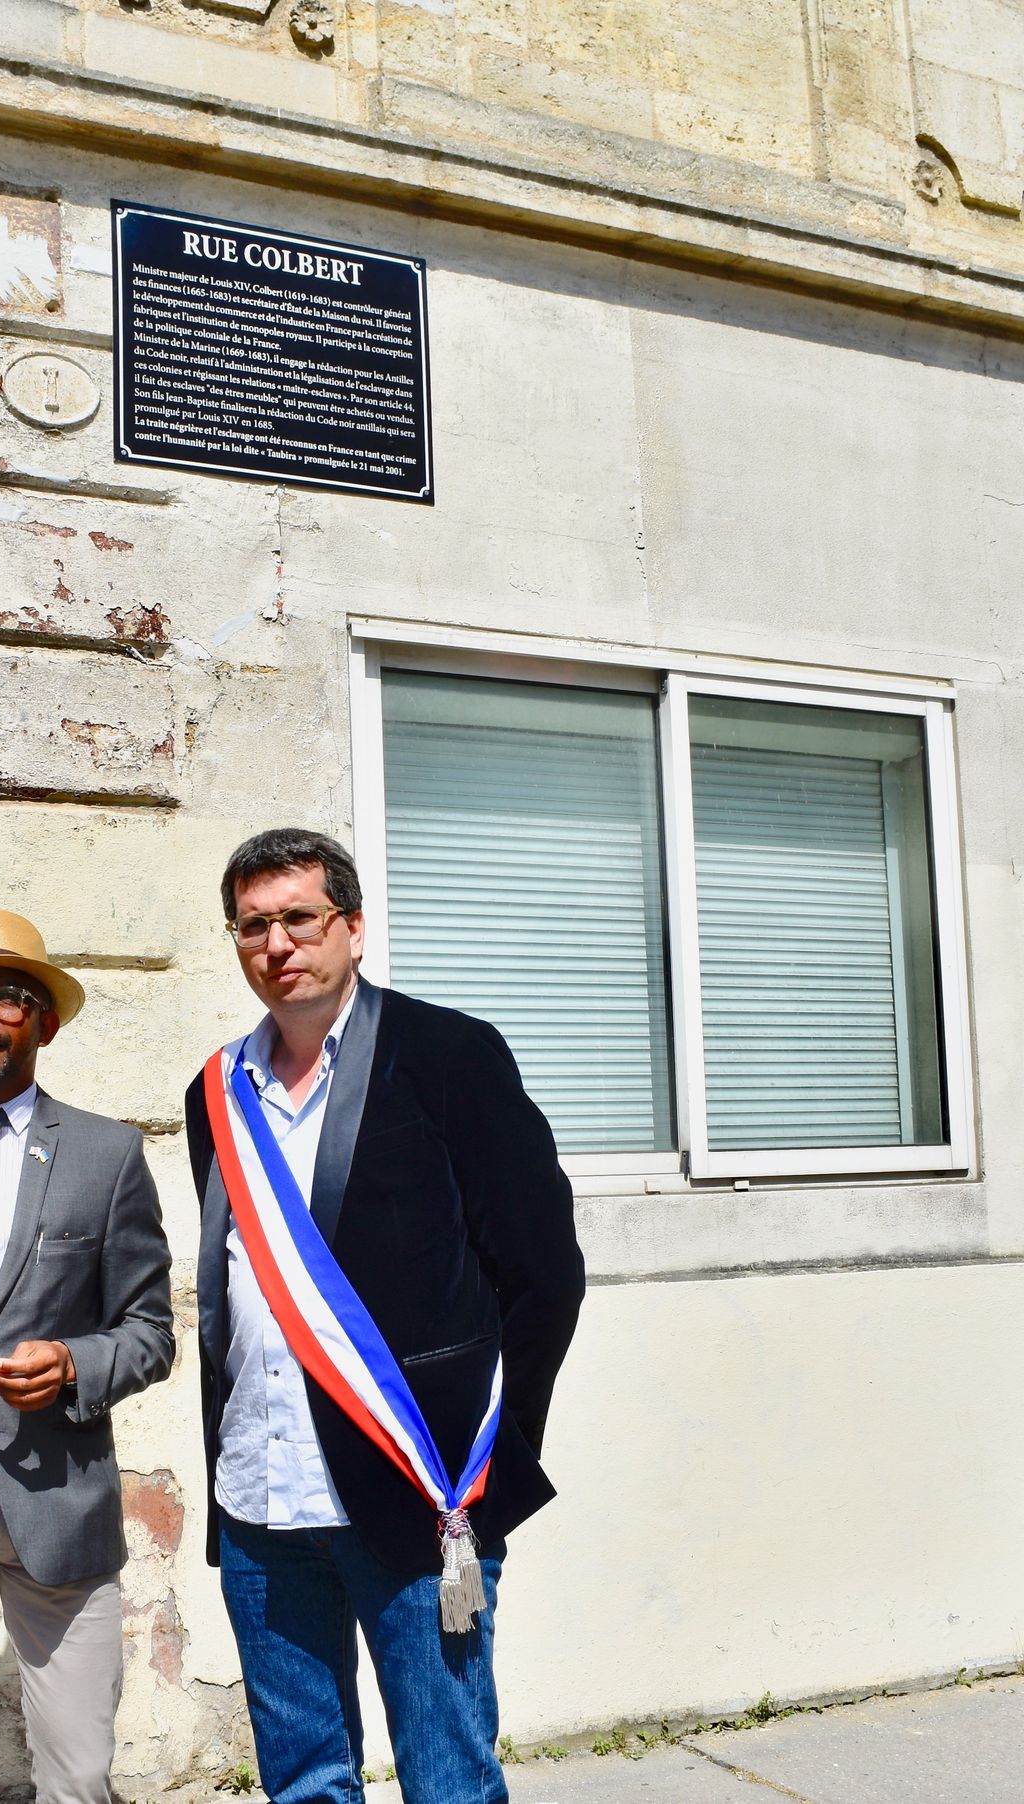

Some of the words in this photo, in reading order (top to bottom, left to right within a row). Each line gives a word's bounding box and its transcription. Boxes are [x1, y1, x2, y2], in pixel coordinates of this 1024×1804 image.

[182, 231, 238, 263] RUE
[244, 243, 363, 285] COLBERT
[132, 262, 168, 277] Ministre
[169, 271, 198, 282] majeur
[199, 274, 209, 284] de
[210, 276, 233, 288] Louis
[233, 280, 252, 292] XIV,
[252, 284, 283, 297] Colbert
[284, 289, 331, 307] (1619-1683)
[331, 300, 342, 308] est
[343, 302, 383, 315] contrôleur
[383, 308, 411, 320] général
[132, 276, 147, 287] des
[148, 278, 181, 293] finances
[182, 285, 231, 302] (1665-1683)
[232, 295, 240, 303] et
[241, 297, 279, 310] secrétaire
[302, 306, 312, 315] de
[313, 307, 320, 317] la
[321, 309, 350, 322] Maison
[350, 314, 361, 324] du
[362, 318, 375, 326] roi.
[376, 319, 382, 328] Il
[382, 320, 411, 333] favorise
[133, 289, 140, 299] le
[140, 291, 203, 310] développement
[203, 302, 215, 312] du
[215, 306, 257, 319] commerce
[257, 313, 265, 321] et
[265, 312, 275, 322] de
[315, 323, 325, 331] en
[325, 323, 351, 335] France
[351, 330, 364, 338] par
[364, 329, 372, 339] la
[372, 333, 402, 344] création
[403, 336, 412, 346] de
[133, 303, 171, 319] fabriques
[172, 312, 180, 320] et
[229, 320, 239, 330] de
[240, 324, 284, 337] monopoles
[285, 331, 314, 342] royaux.
[315, 334, 321, 343] Il
[322, 338, 357, 351] participe
[357, 342, 362, 350] à
[363, 342, 370, 352] la
[371, 346, 412, 359] conception
[133, 317, 144, 327] de
[145, 319, 153, 329] la
[155, 322, 192, 336] politique
[193, 328, 230, 341] coloniale
[231, 334, 242, 343] de
[243, 335, 251, 345] la
[252, 337, 281, 350] France.
[133, 345, 145, 355] du
[146, 347, 169, 359] Code
[170, 353, 189, 363] noir,
[190, 355, 214, 366] relatif
[214, 358, 219, 367] à
[292, 370, 300, 380] la
[300, 371, 344, 387] légalisation
[345, 379, 355, 388] de
[394, 387, 412, 398] dans
[134, 331, 169, 345] Ministre
[170, 337, 181, 347] de
[181, 339, 189, 348] la
[190, 340, 220, 353] Marine
[221, 345, 272, 363] (1669-1683),
[273, 354, 279, 363] il
[280, 357, 307, 369] engage
[308, 359, 315, 369] la
[316, 362, 353, 375] rédaction
[354, 369, 372, 378] pour
[373, 370, 384, 380] les
[385, 373, 414, 385] Antilles
[134, 373, 140, 382] il
[142, 374, 155, 385] fait
[157, 377, 171, 387] des
[172, 380, 205, 392] esclaves
[224, 387, 244, 398] êtres
[283, 398, 296, 407] qui
[297, 400, 328, 411] peuvent
[329, 403, 345, 413] être
[346, 407, 374, 418] achetés
[386, 414, 415, 424] vendus.
[134, 387, 150, 398] Son
[152, 389, 164, 400] fils
[165, 392, 219, 408] Jean-Baptiste
[220, 400, 257, 413] finalisera
[258, 405, 265, 415] la
[267, 408, 304, 421] rédaction
[305, 413, 315, 422] du
[316, 415, 338, 426] Code
[339, 420, 355, 428] noir
[356, 423, 386, 433] antillais
[386, 427, 399, 437] qui
[400, 430, 415, 438] sera
[148, 362, 182, 375] colonies
[192, 369, 228, 382] régissant
[229, 374, 240, 384] les
[241, 376, 276, 389] relations
[282, 384, 341, 399] maître-esclaves
[350, 393, 363, 403] Par
[379, 400, 402, 409] article
[403, 402, 414, 412] 44,
[134, 404, 180, 417] promulgué
[181, 410, 196, 419] par
[198, 410, 220, 422] Louis
[222, 414, 239, 424] XIV
[254, 419, 274, 430] 1685.
[134, 415, 145, 425] La
[146, 418, 168, 429] traite
[169, 421, 203, 433] négrière
[204, 427, 212, 435] et
[254, 435, 268, 443] ont
[269, 435, 281, 444] été
[281, 439, 317, 450] reconnus
[328, 443, 354, 455] France
[364, 450, 380, 459] tant
[380, 453, 394, 462] que
[395, 455, 416, 464] crime
[134, 432, 161, 442] contre
[207, 442, 221, 451] par
[222, 441, 230, 451] la
[231, 443, 242, 453] loi
[243, 445, 259, 455] dite
[266, 448, 296, 460] Taubira
[304, 455, 350, 468] promulguée
[350, 460, 358, 469] le
[359, 462, 367, 470] 21
[369, 465, 384, 473] mai
[385, 465, 405, 476] 2001.
